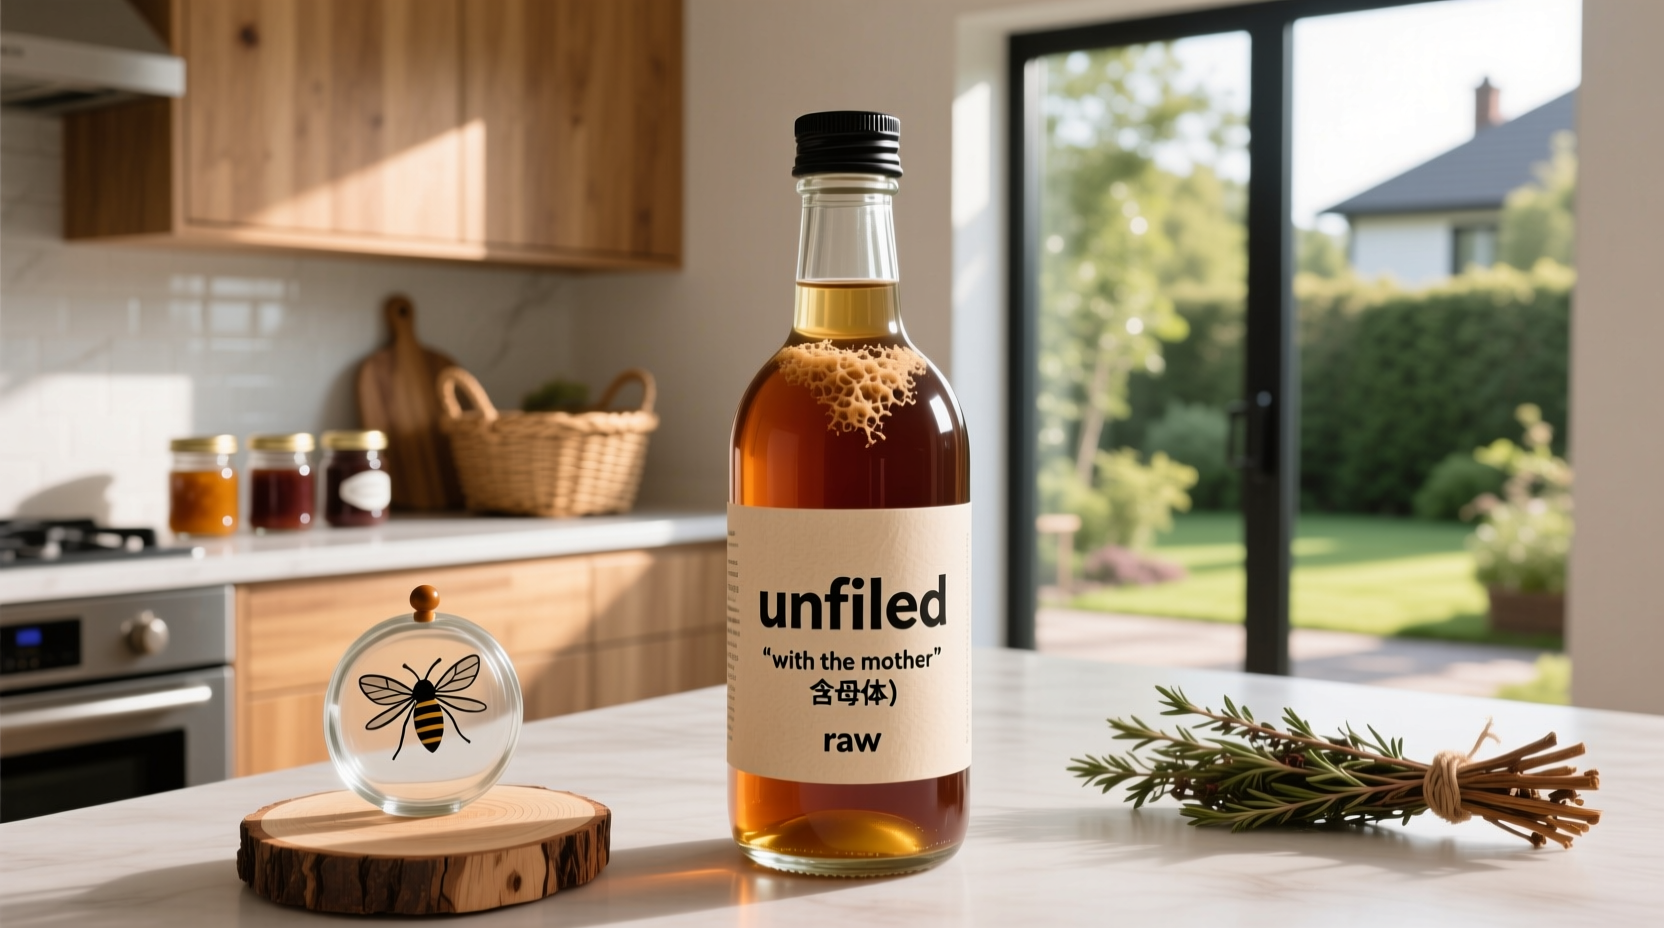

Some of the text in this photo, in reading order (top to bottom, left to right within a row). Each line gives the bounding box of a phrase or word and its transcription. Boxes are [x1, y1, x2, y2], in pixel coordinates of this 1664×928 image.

[759, 573, 947, 631] unfiled
[819, 650, 856, 671] the
[823, 732, 882, 753] raw
